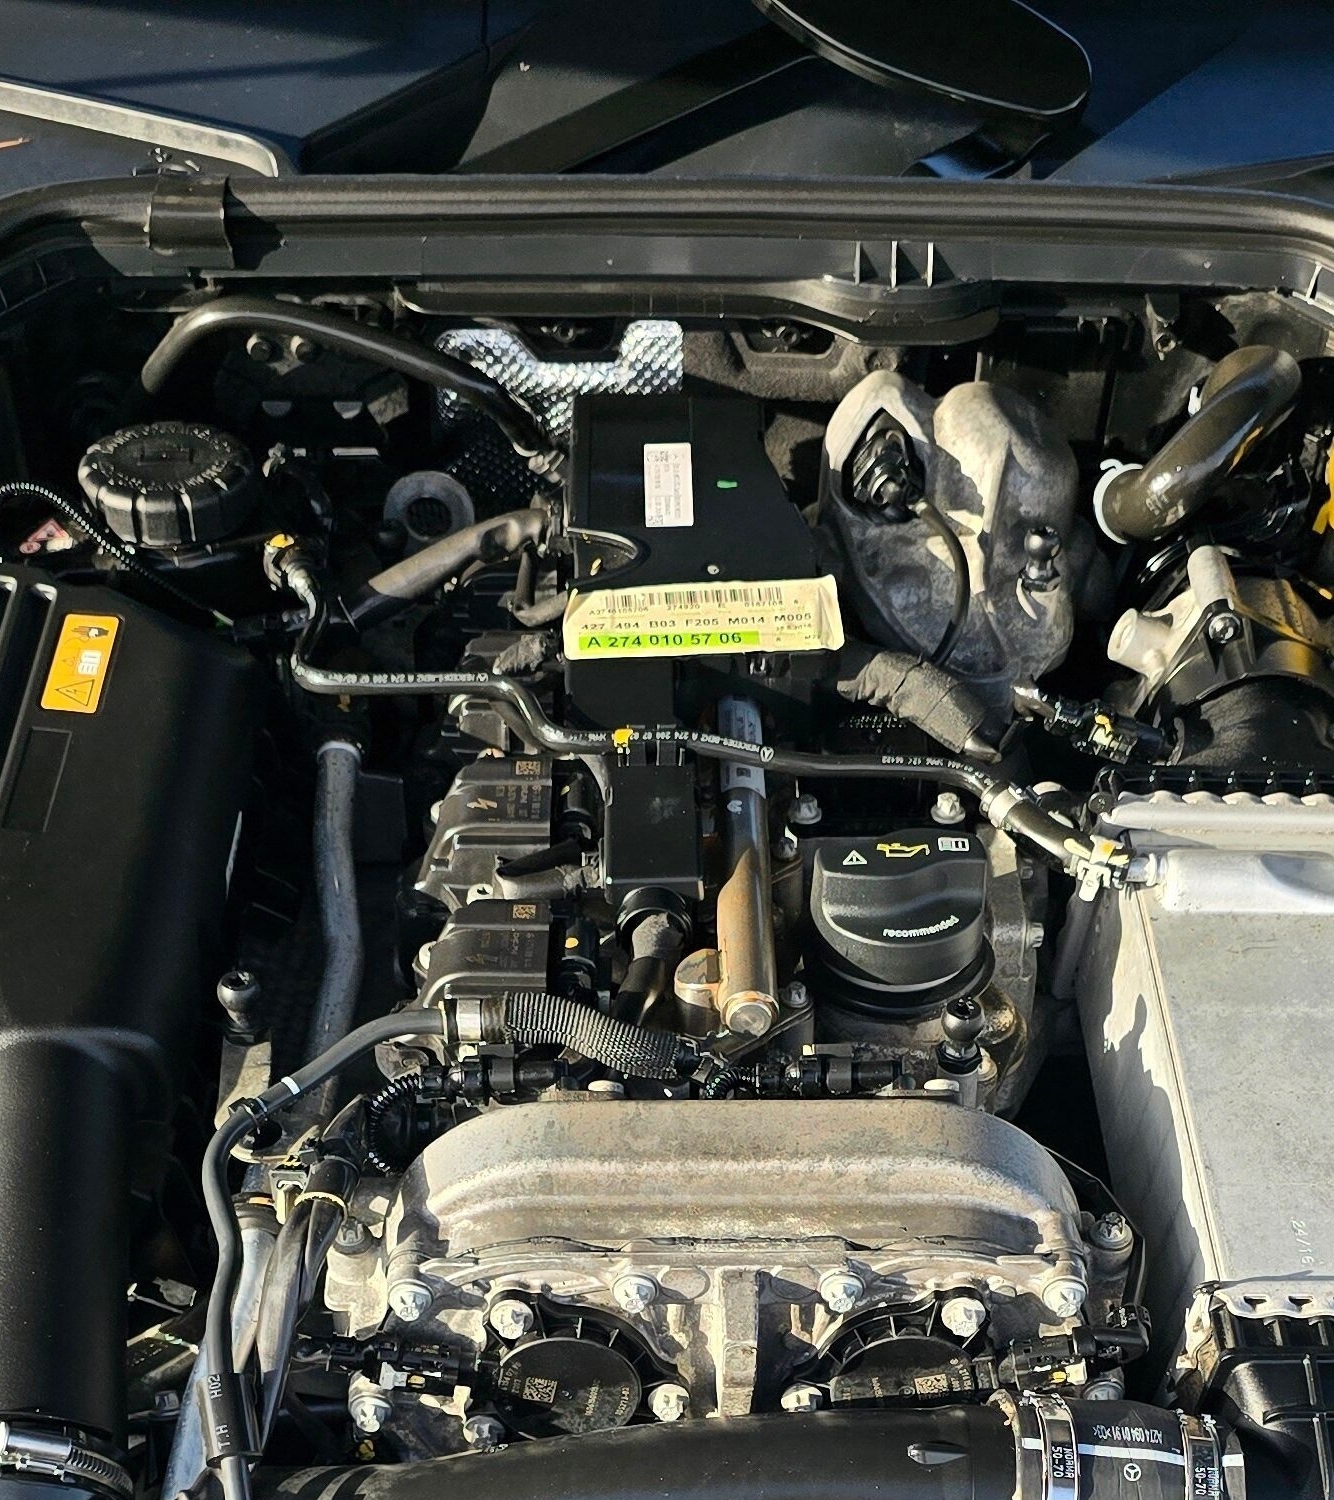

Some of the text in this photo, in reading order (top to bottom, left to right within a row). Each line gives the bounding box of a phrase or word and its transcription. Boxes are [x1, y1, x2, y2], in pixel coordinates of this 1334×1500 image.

[728, 616, 765, 625] M014
[587, 632, 742, 648] A 274 010 57 06
[883, 914, 960, 938] recommended
[207, 1374, 223, 1400] H02
[1051, 1446, 1064, 1478] 50-70
[1064, 1448, 1075, 1480] NORMA
[1195, 1467, 1207, 1496] 50-70
